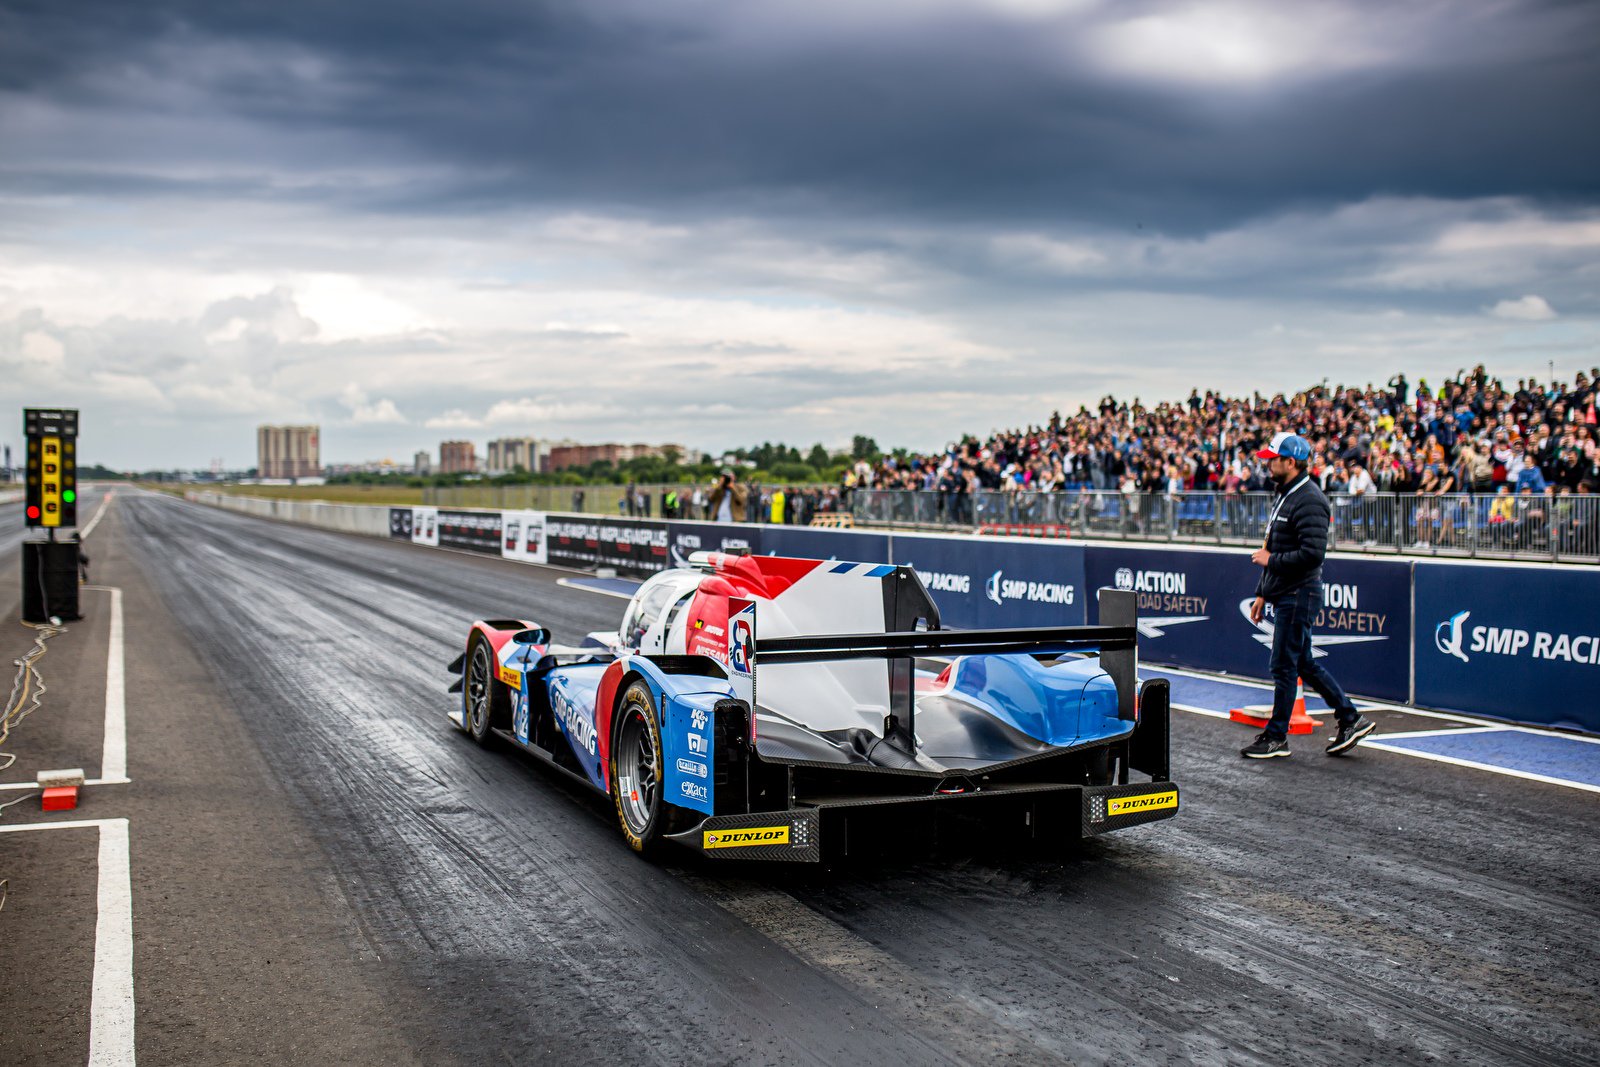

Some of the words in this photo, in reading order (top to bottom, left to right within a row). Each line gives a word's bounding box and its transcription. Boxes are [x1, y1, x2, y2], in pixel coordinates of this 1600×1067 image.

[916, 570, 932, 589] MP
[932, 572, 970, 594] RACING
[1001, 579, 1027, 600] SMP
[1027, 582, 1074, 605] RACING
[1135, 570, 1186, 595] ACTION
[1137, 592, 1162, 611] OAD
[1163, 594, 1208, 615] SAFETY
[1328, 611, 1387, 633] SAFETY
[695, 644, 728, 663] NISSAN
[1470, 625, 1530, 656] SMP
[1532, 631, 1600, 666] RACI
[566, 705, 598, 756] RACING
[1121, 796, 1174, 809] DUNLOP
[720, 831, 784, 843] DUNLOP
